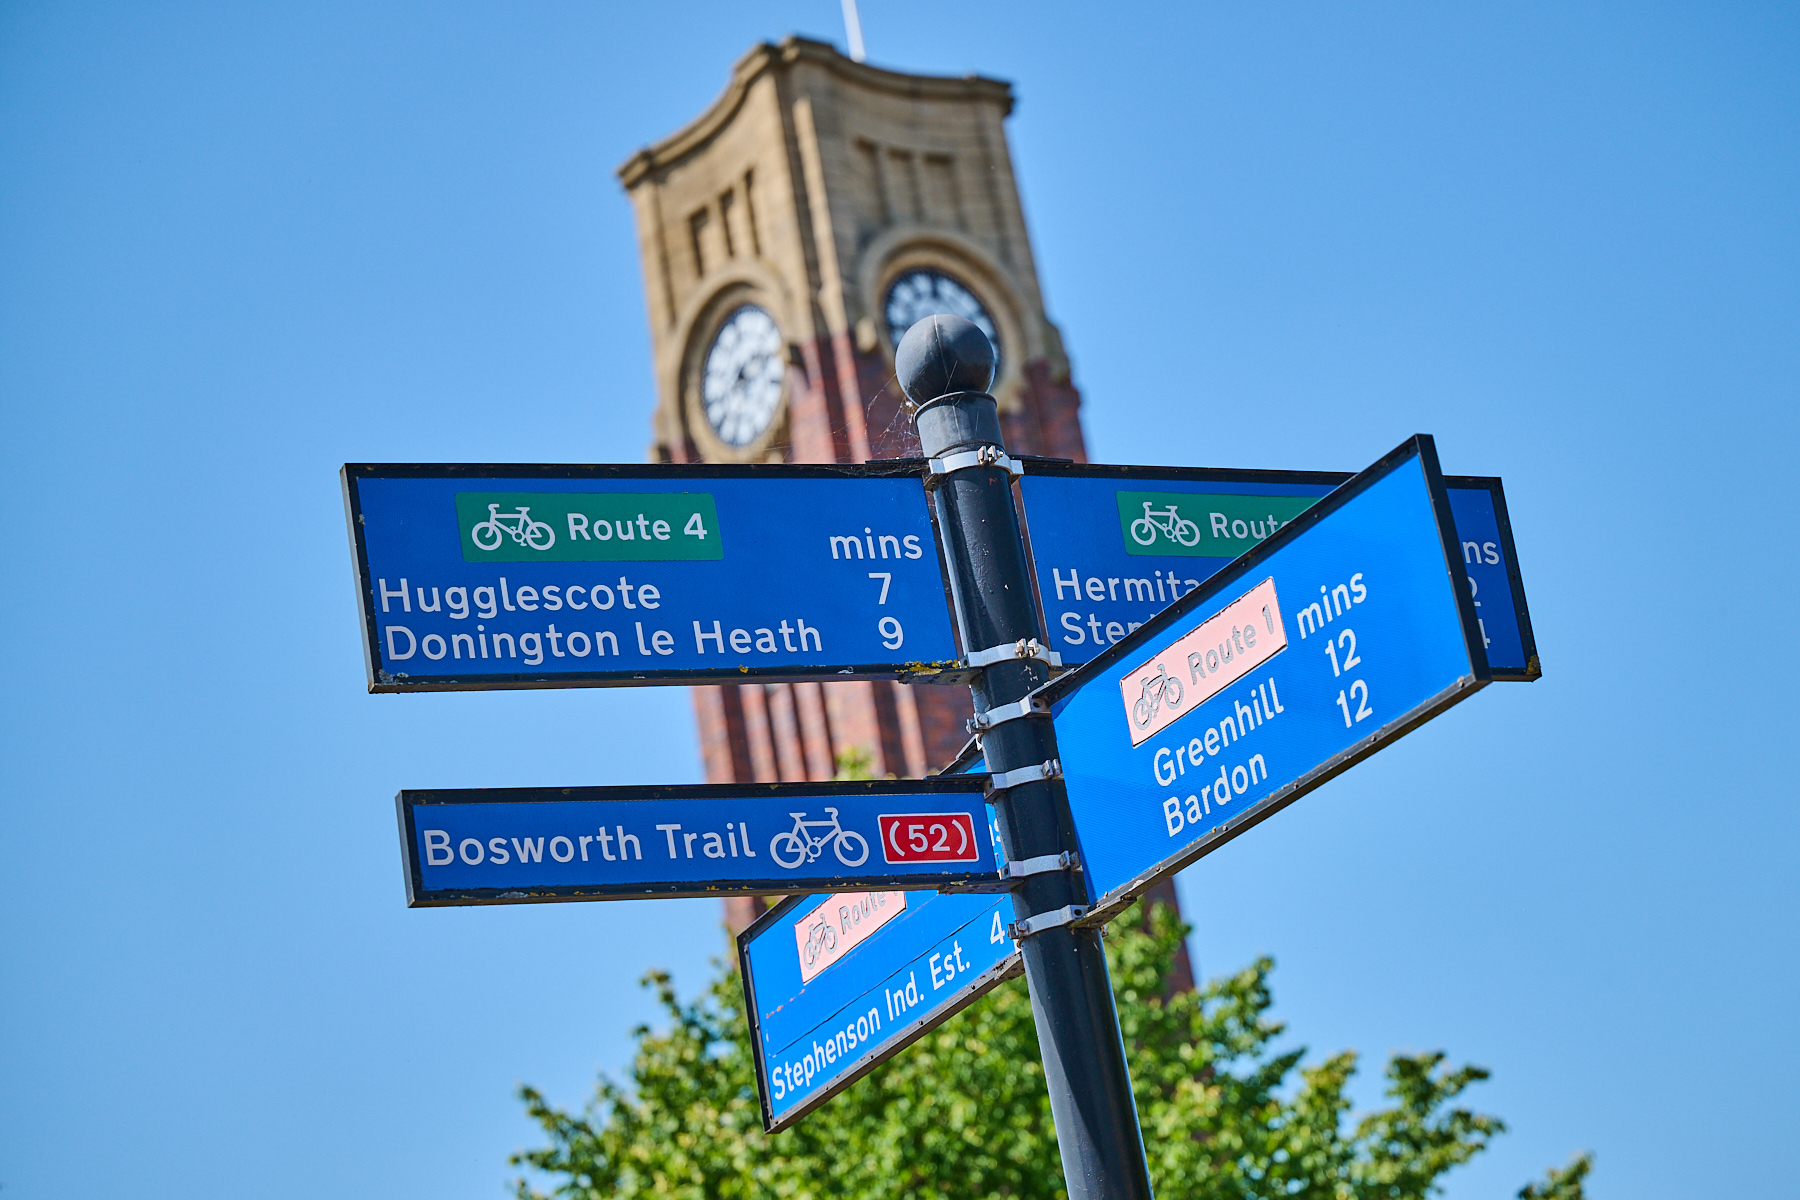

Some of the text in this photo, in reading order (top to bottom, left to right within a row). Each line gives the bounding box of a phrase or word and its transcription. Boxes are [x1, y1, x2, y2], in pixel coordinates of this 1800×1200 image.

[568, 513, 708, 541] Route 4
[830, 527, 923, 560] mins
[1209, 512, 1290, 540] Rout
[379, 572, 892, 620] Hugglescote 7
[1297, 573, 1367, 639] mins
[386, 616, 904, 666] Donington le Heath 9
[1188, 603, 1275, 686] Route 1
[1153, 628, 1362, 787] Greenhill 12
[1163, 679, 1373, 838] Bardon 12
[424, 825, 642, 866] Bosworth
[656, 822, 756, 859] Trail
[889, 819, 968, 857] (52)
[839, 891, 887, 935] Route
[772, 910, 1006, 1101] Stephenson Ind. Est. 4
